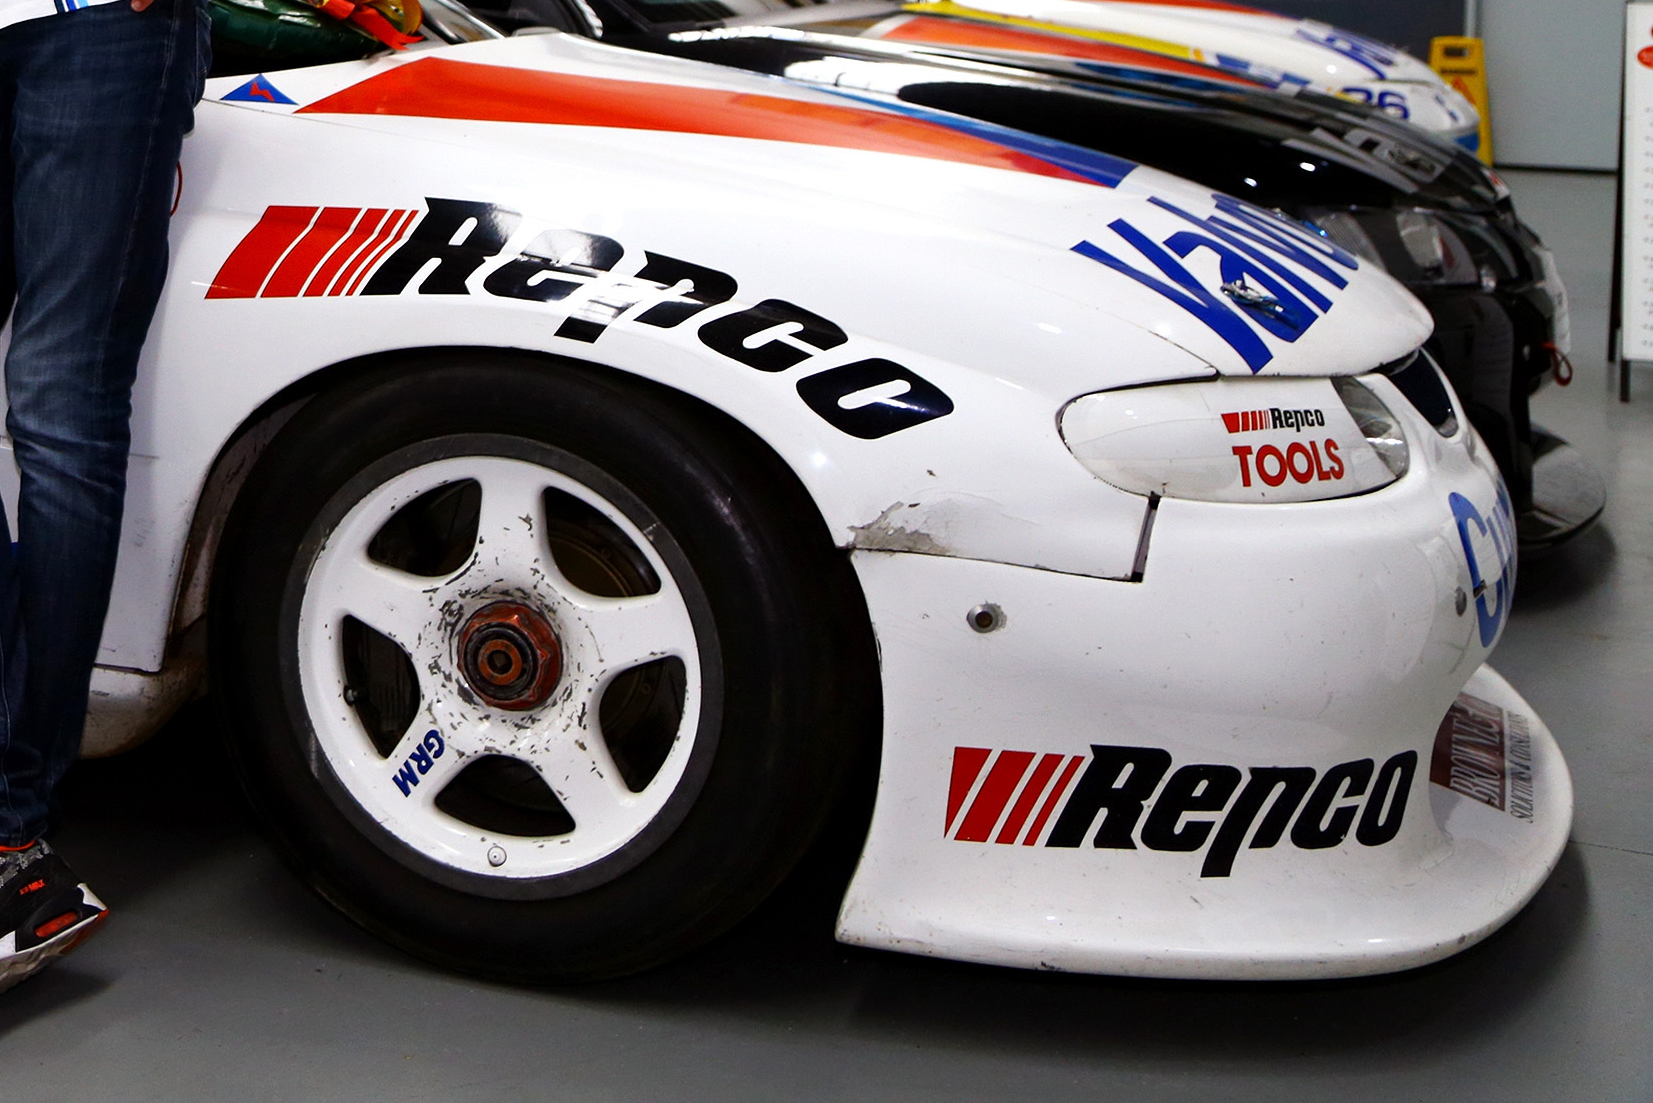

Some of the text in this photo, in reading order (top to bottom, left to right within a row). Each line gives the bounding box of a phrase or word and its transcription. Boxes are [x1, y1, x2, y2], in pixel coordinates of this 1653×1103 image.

[360, 196, 954, 440] Repco
[1269, 407, 1326, 433] Repco
[1231, 438, 1345, 488] TOOLS
[392, 729, 446, 797] GRM
[1045, 744, 1419, 879] Repco
